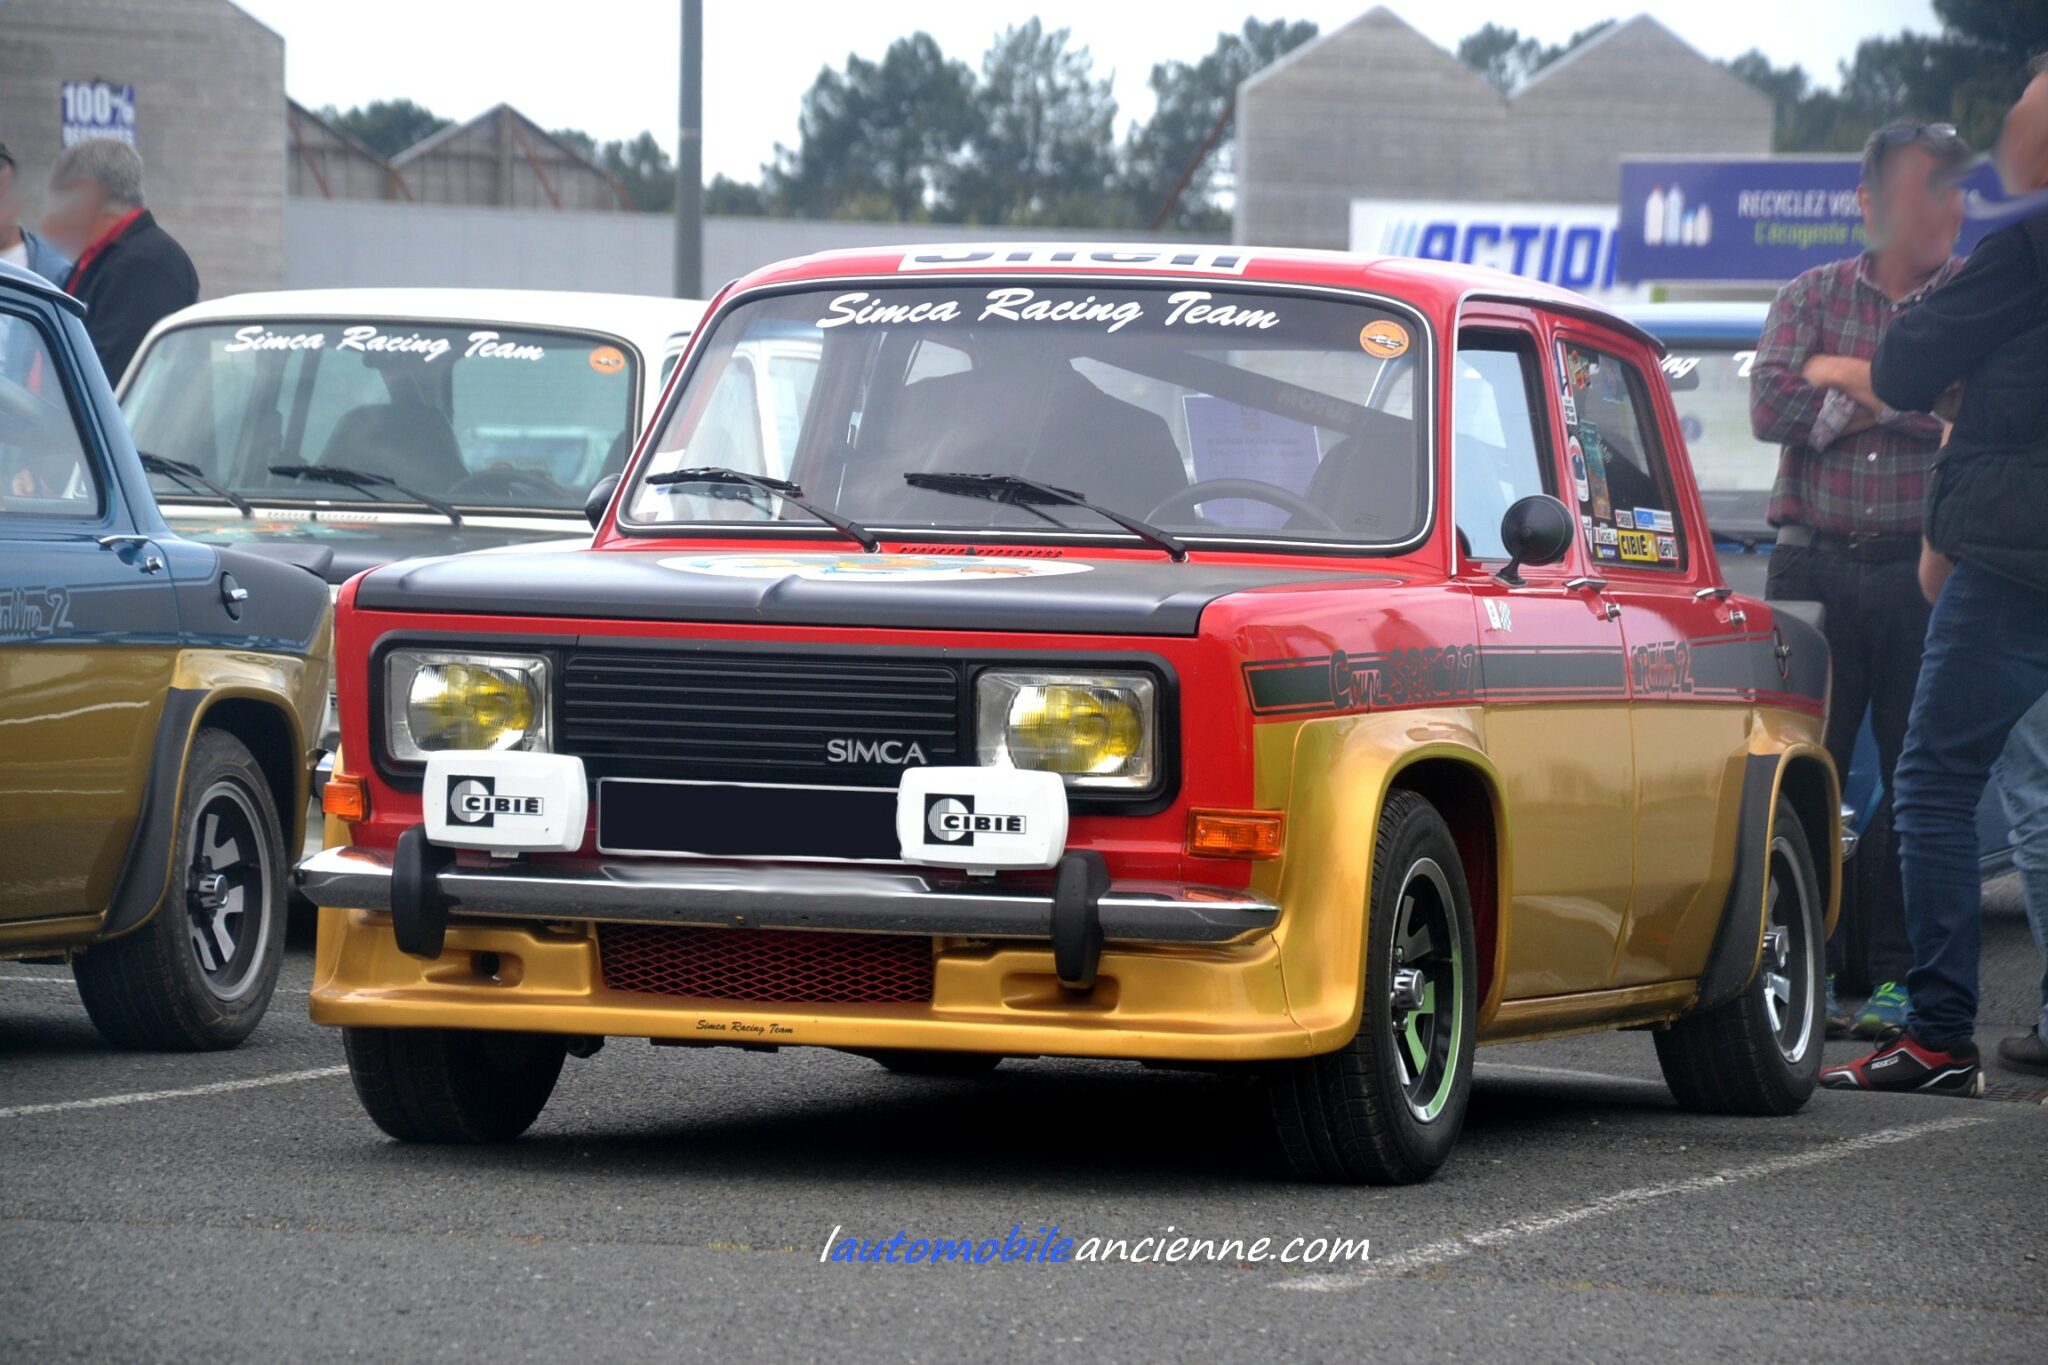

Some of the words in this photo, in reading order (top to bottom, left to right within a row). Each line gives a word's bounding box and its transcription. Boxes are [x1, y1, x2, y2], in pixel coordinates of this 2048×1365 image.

[64, 85, 135, 125] 100%
[1738, 190, 1826, 217] RECYCLEZ
[816, 292, 960, 328] Simca
[978, 288, 1144, 333] Racing
[1165, 291, 1279, 329] Team
[225, 326, 325, 351] Simca
[337, 326, 451, 362] Racing
[464, 332, 544, 360] Team
[46, 587, 74, 635] 2
[827, 739, 927, 765] SIMCA
[696, 1020, 725, 1030] Simca
[731, 1021, 765, 1035] Racing
[770, 1024, 793, 1034] Team
